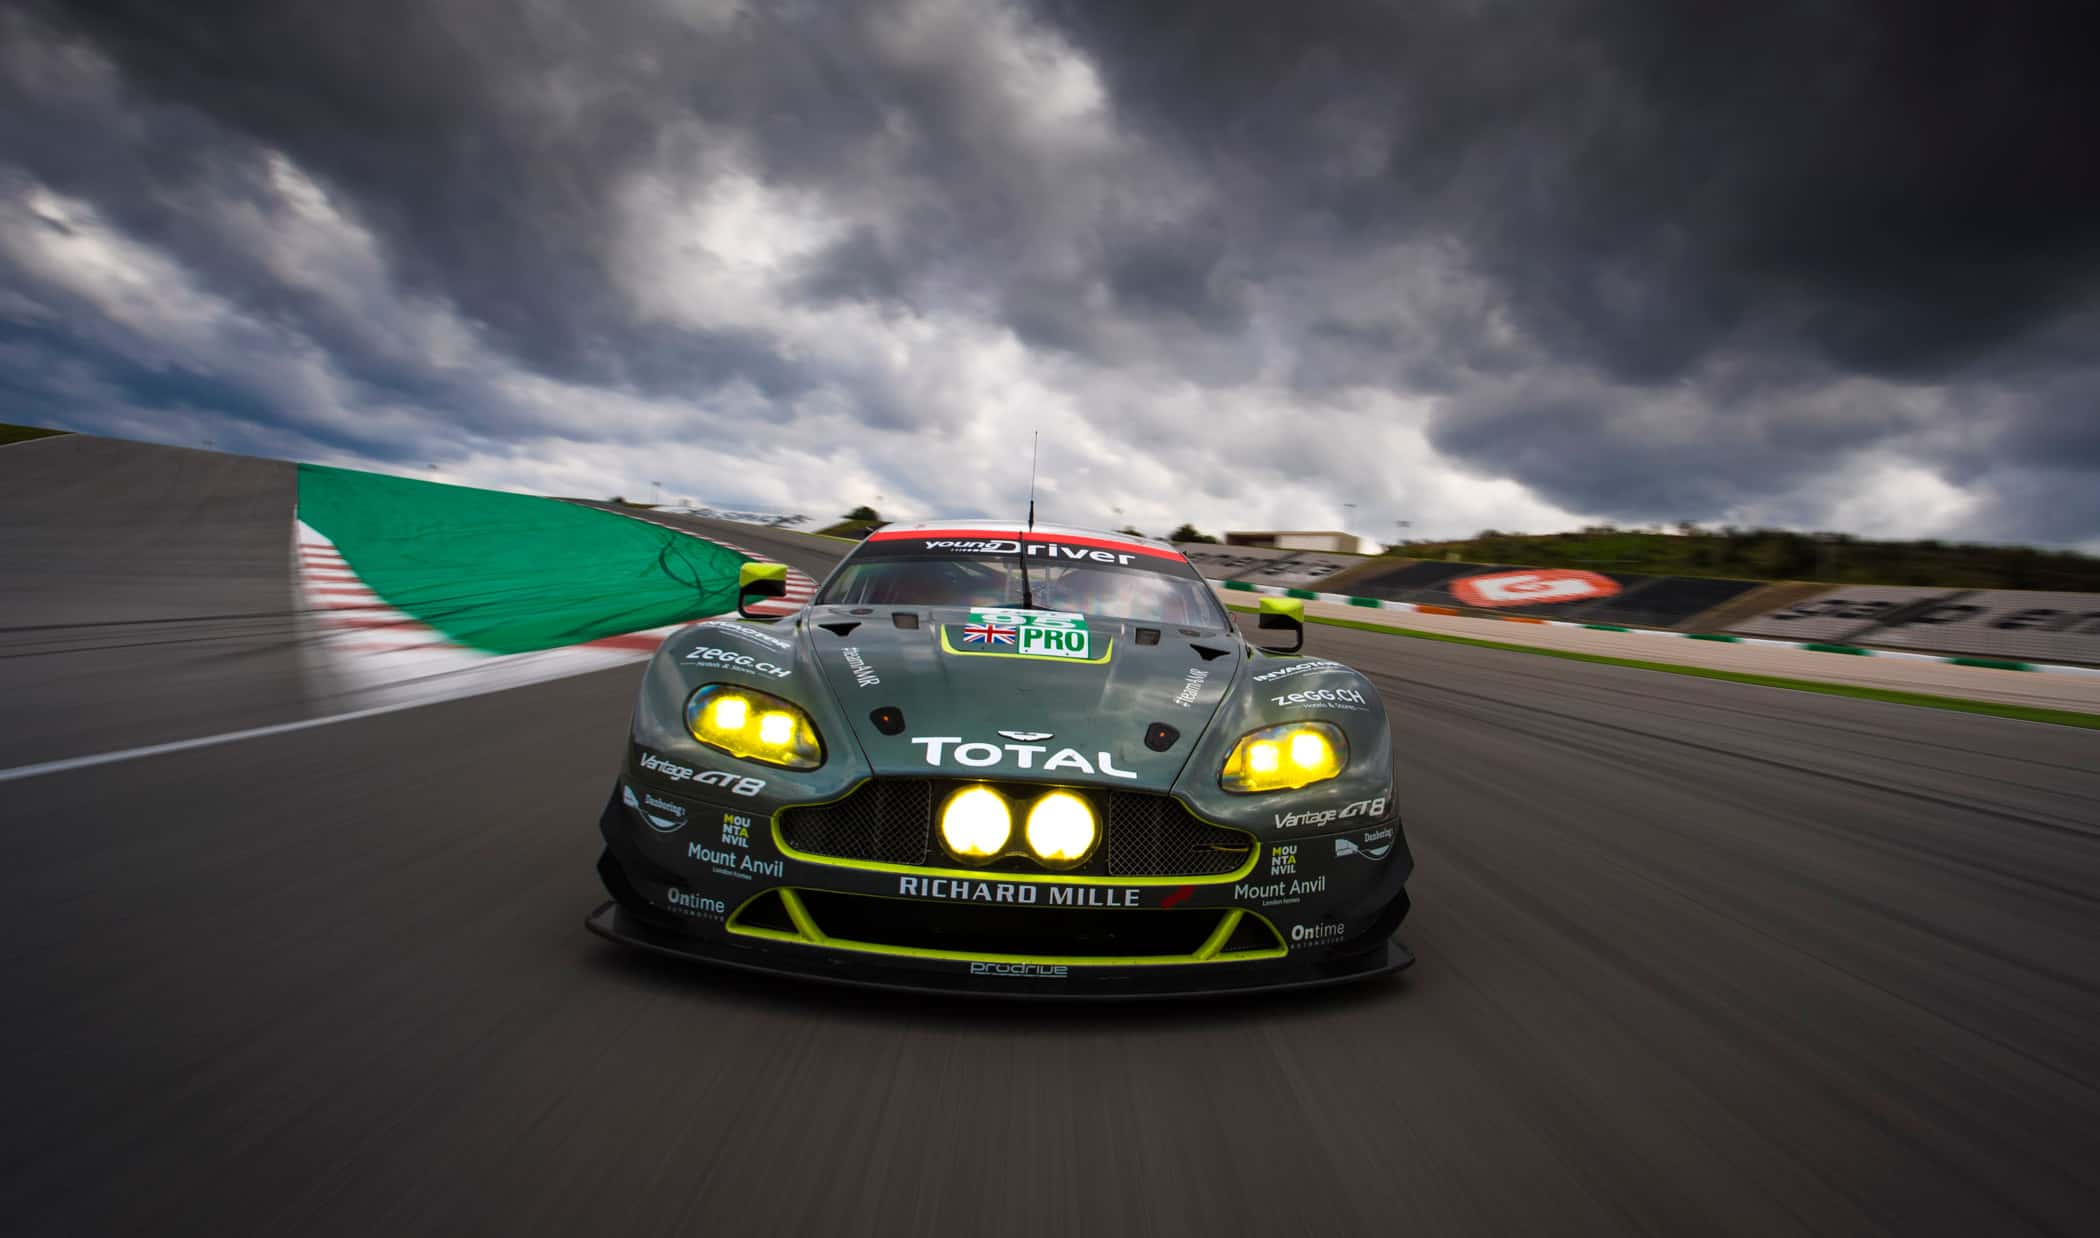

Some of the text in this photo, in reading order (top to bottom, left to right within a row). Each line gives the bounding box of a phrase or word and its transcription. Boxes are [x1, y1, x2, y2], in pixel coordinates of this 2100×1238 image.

[1023, 628, 1086, 652] PRO
[911, 736, 1138, 779] TOTAL
[640, 751, 767, 797] Vantage GT8
[723, 813, 751, 828] MOU
[1274, 798, 1386, 829] Vantage GT8
[721, 834, 749, 849] NVIL
[722, 824, 749, 838] NTA
[688, 841, 784, 878] Mount Anvil
[1271, 855, 1297, 866] NTA
[1272, 845, 1298, 857] MOU
[1271, 863, 1297, 876] NVIL
[899, 875, 1140, 907] RICHARD MILLE
[1234, 875, 1326, 900] Mount Anvil
[667, 887, 725, 913] Ontime
[1291, 922, 1345, 941] Ontime
[970, 961, 1069, 976] prodrive
